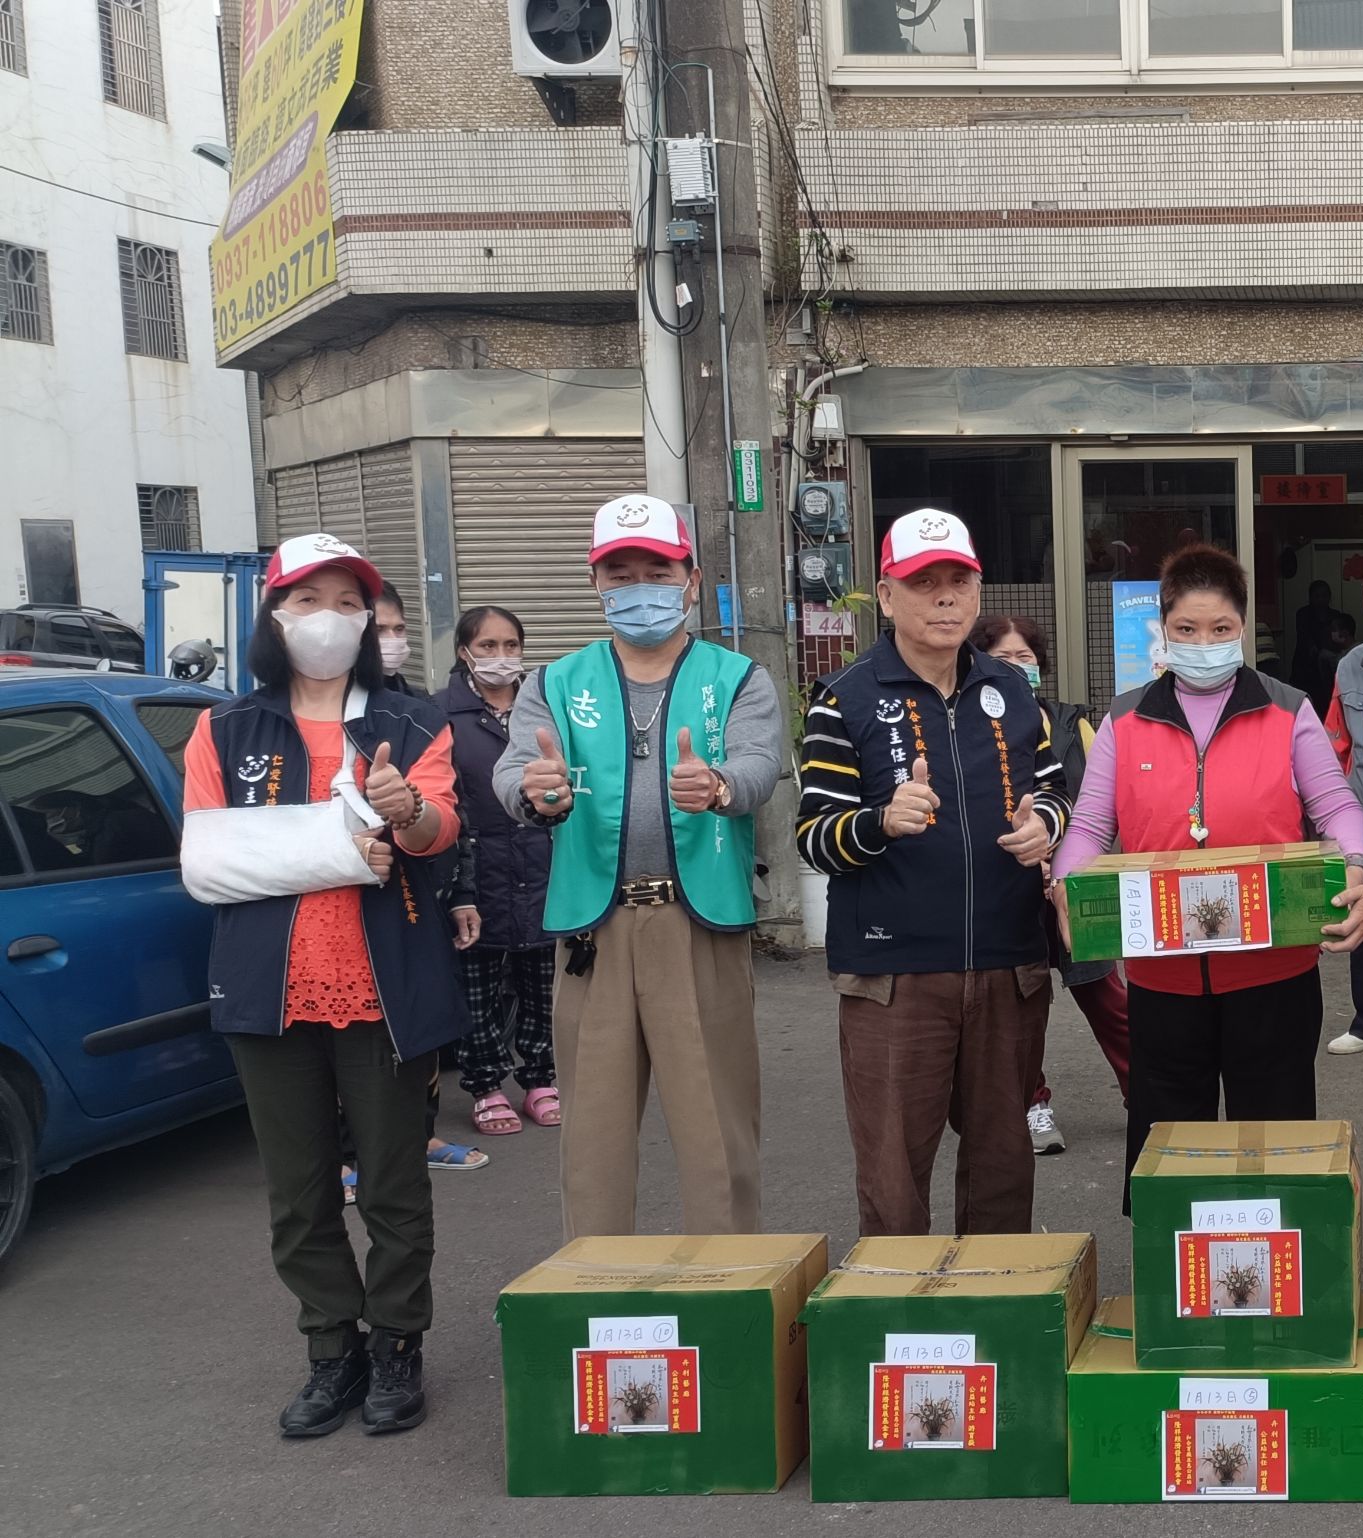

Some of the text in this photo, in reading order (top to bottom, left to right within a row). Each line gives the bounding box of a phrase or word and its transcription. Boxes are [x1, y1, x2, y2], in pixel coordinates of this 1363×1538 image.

[216, 169, 327, 295] 0937-118806
[219, 228, 330, 342] 03-4899777
[819, 617, 843, 633] 44
[1119, 596, 1155, 609] TRAVEL
[567, 689, 601, 796] 志工
